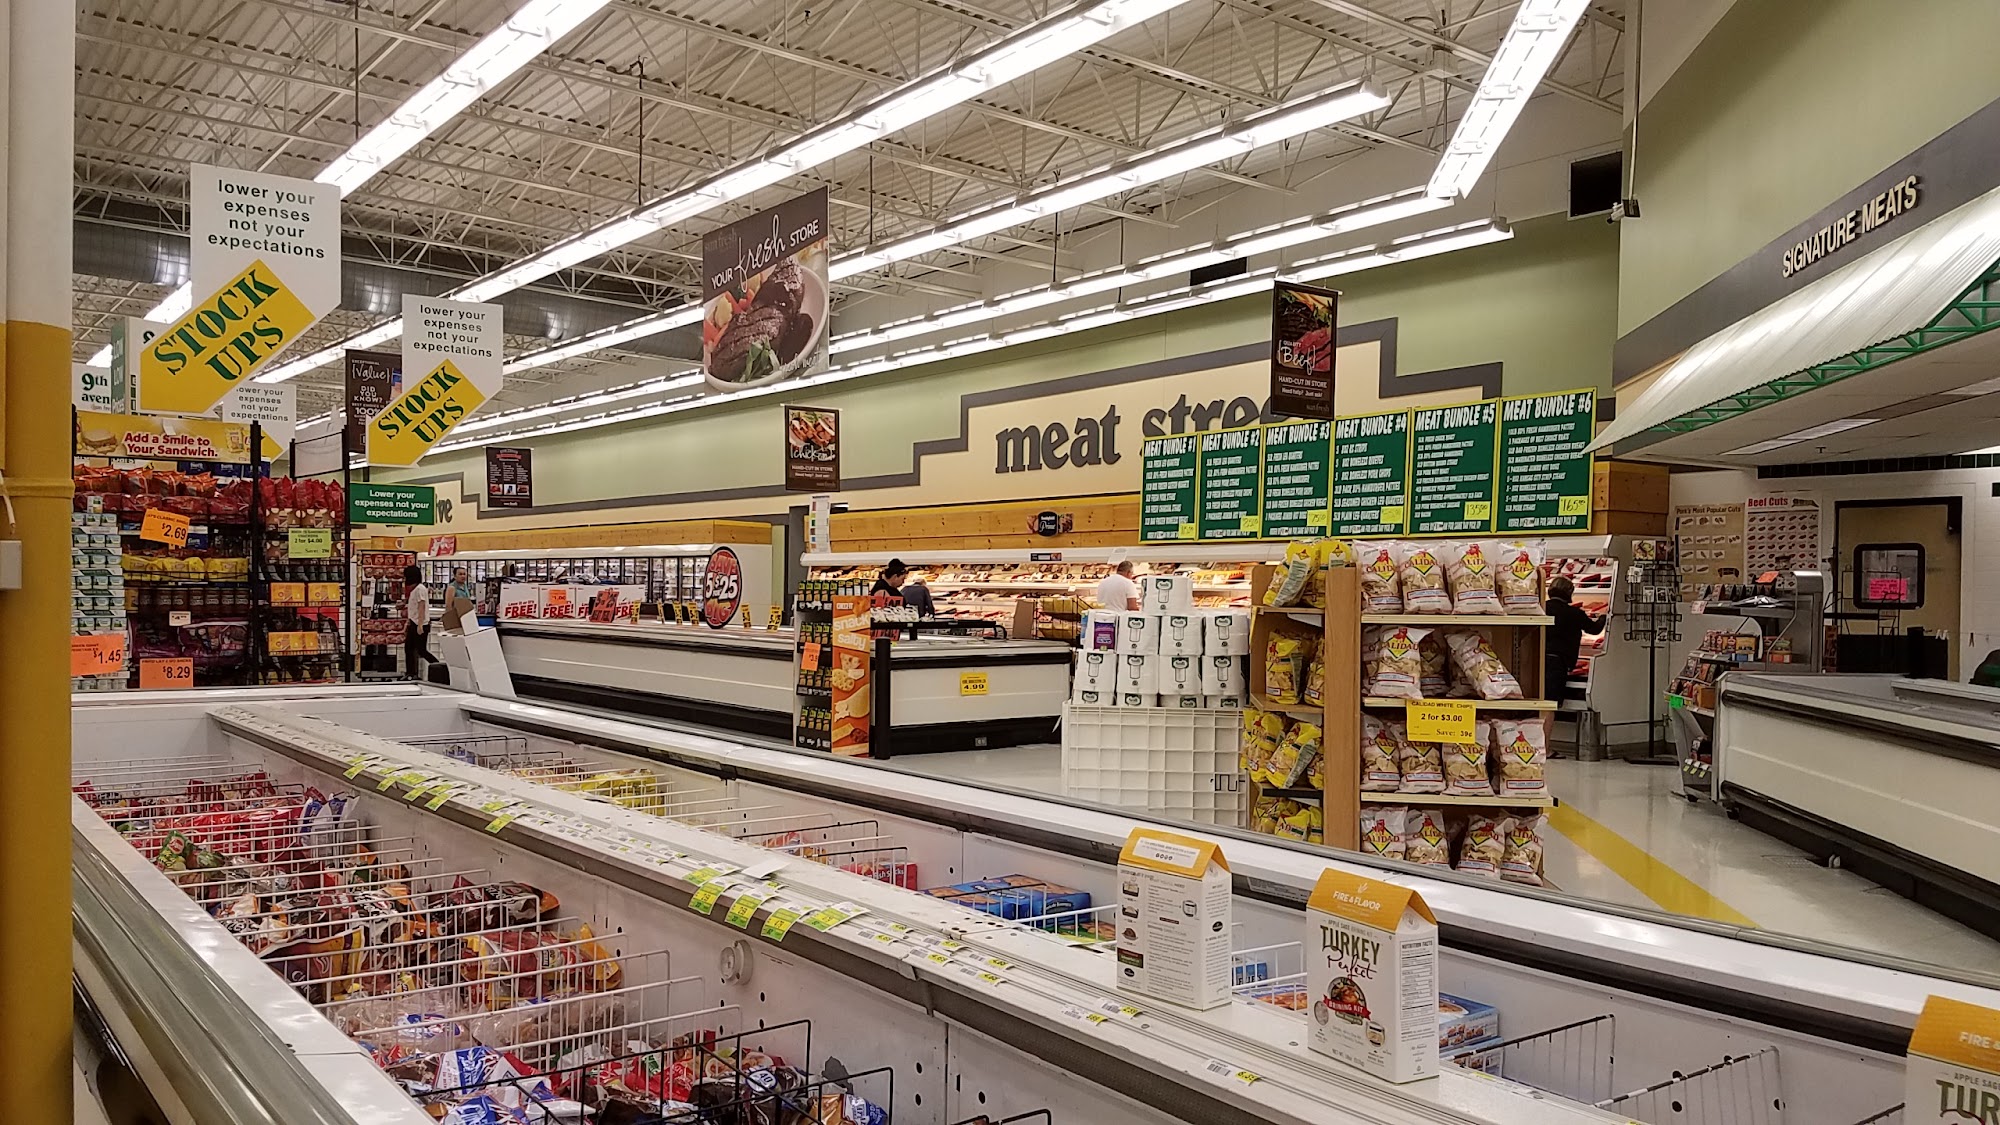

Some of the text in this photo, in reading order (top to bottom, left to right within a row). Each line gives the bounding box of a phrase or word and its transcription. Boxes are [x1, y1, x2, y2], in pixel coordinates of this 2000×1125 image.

[218, 180, 316, 205] lower your
[224, 201, 310, 222] expenses
[229, 218, 305, 238] not your
[1782, 175, 1918, 278] SIGNATURE MEATS
[208, 234, 324, 259] expectations
[711, 214, 819, 293] YOUR fresh STORE
[420, 304, 486, 320] lower your
[154, 268, 280, 376] STOCK
[424, 318, 482, 332] expenses
[428, 330, 478, 344] not your
[204, 314, 285, 382] UPS
[413, 341, 492, 358] expectations
[81, 372, 108, 390] 9th
[81, 392, 110, 404] aven
[264, 388, 284, 396] your
[238, 396, 282, 405] expenses
[378, 366, 461, 440] STOCK
[1504, 392, 1592, 421] MEAT BUNDLE #6
[230, 410, 289, 422] expectations
[258, 405, 279, 413] your
[411, 396, 464, 443] UPS
[1415, 404, 1496, 431] MEAT BUNDLE #5
[1266, 427, 1288, 445] MEAT
[1288, 423, 1319, 443] BUNDLE
[1336, 414, 1407, 439] MEAT BUNDLE #4
[124, 432, 210, 446] Add a Smile to
[995, 404, 1121, 474] meat
[1202, 434, 1221, 452] MEAT
[126, 443, 218, 458] Your Sandwich.
[369, 490, 415, 501] Lower your
[1748, 497, 1788, 507] Beef Cuts
[354, 500, 430, 511] expenses not your
[1706, 506, 1726, 514] Popular
[366, 510, 418, 520] expectations
[161, 522, 187, 540] $2.69
[504, 603, 537, 618] FREE!
[542, 604, 574, 618] FREE!
[833, 614, 870, 630] snack
[838, 633, 866, 650] salty
[93, 650, 121, 664] $1.45
[162, 666, 190, 679] $8.29
[1441, 714, 1462, 722] $3.00
[1436, 728, 1456, 736] Save:
[1362, 835, 1399, 843] ALIDAD
[1333, 891, 1349, 903] FIRE
[1354, 896, 1381, 911] FLAVOR
[1320, 924, 1380, 966] TURKEY
[1322, 945, 1378, 982] Perfect
[1328, 1001, 1363, 1013] BRINING KIT
[1960, 1031, 1992, 1049] FIRE
[1954, 1073, 1979, 1086] APPLE
[1936, 1079, 2000, 1125] TUR
